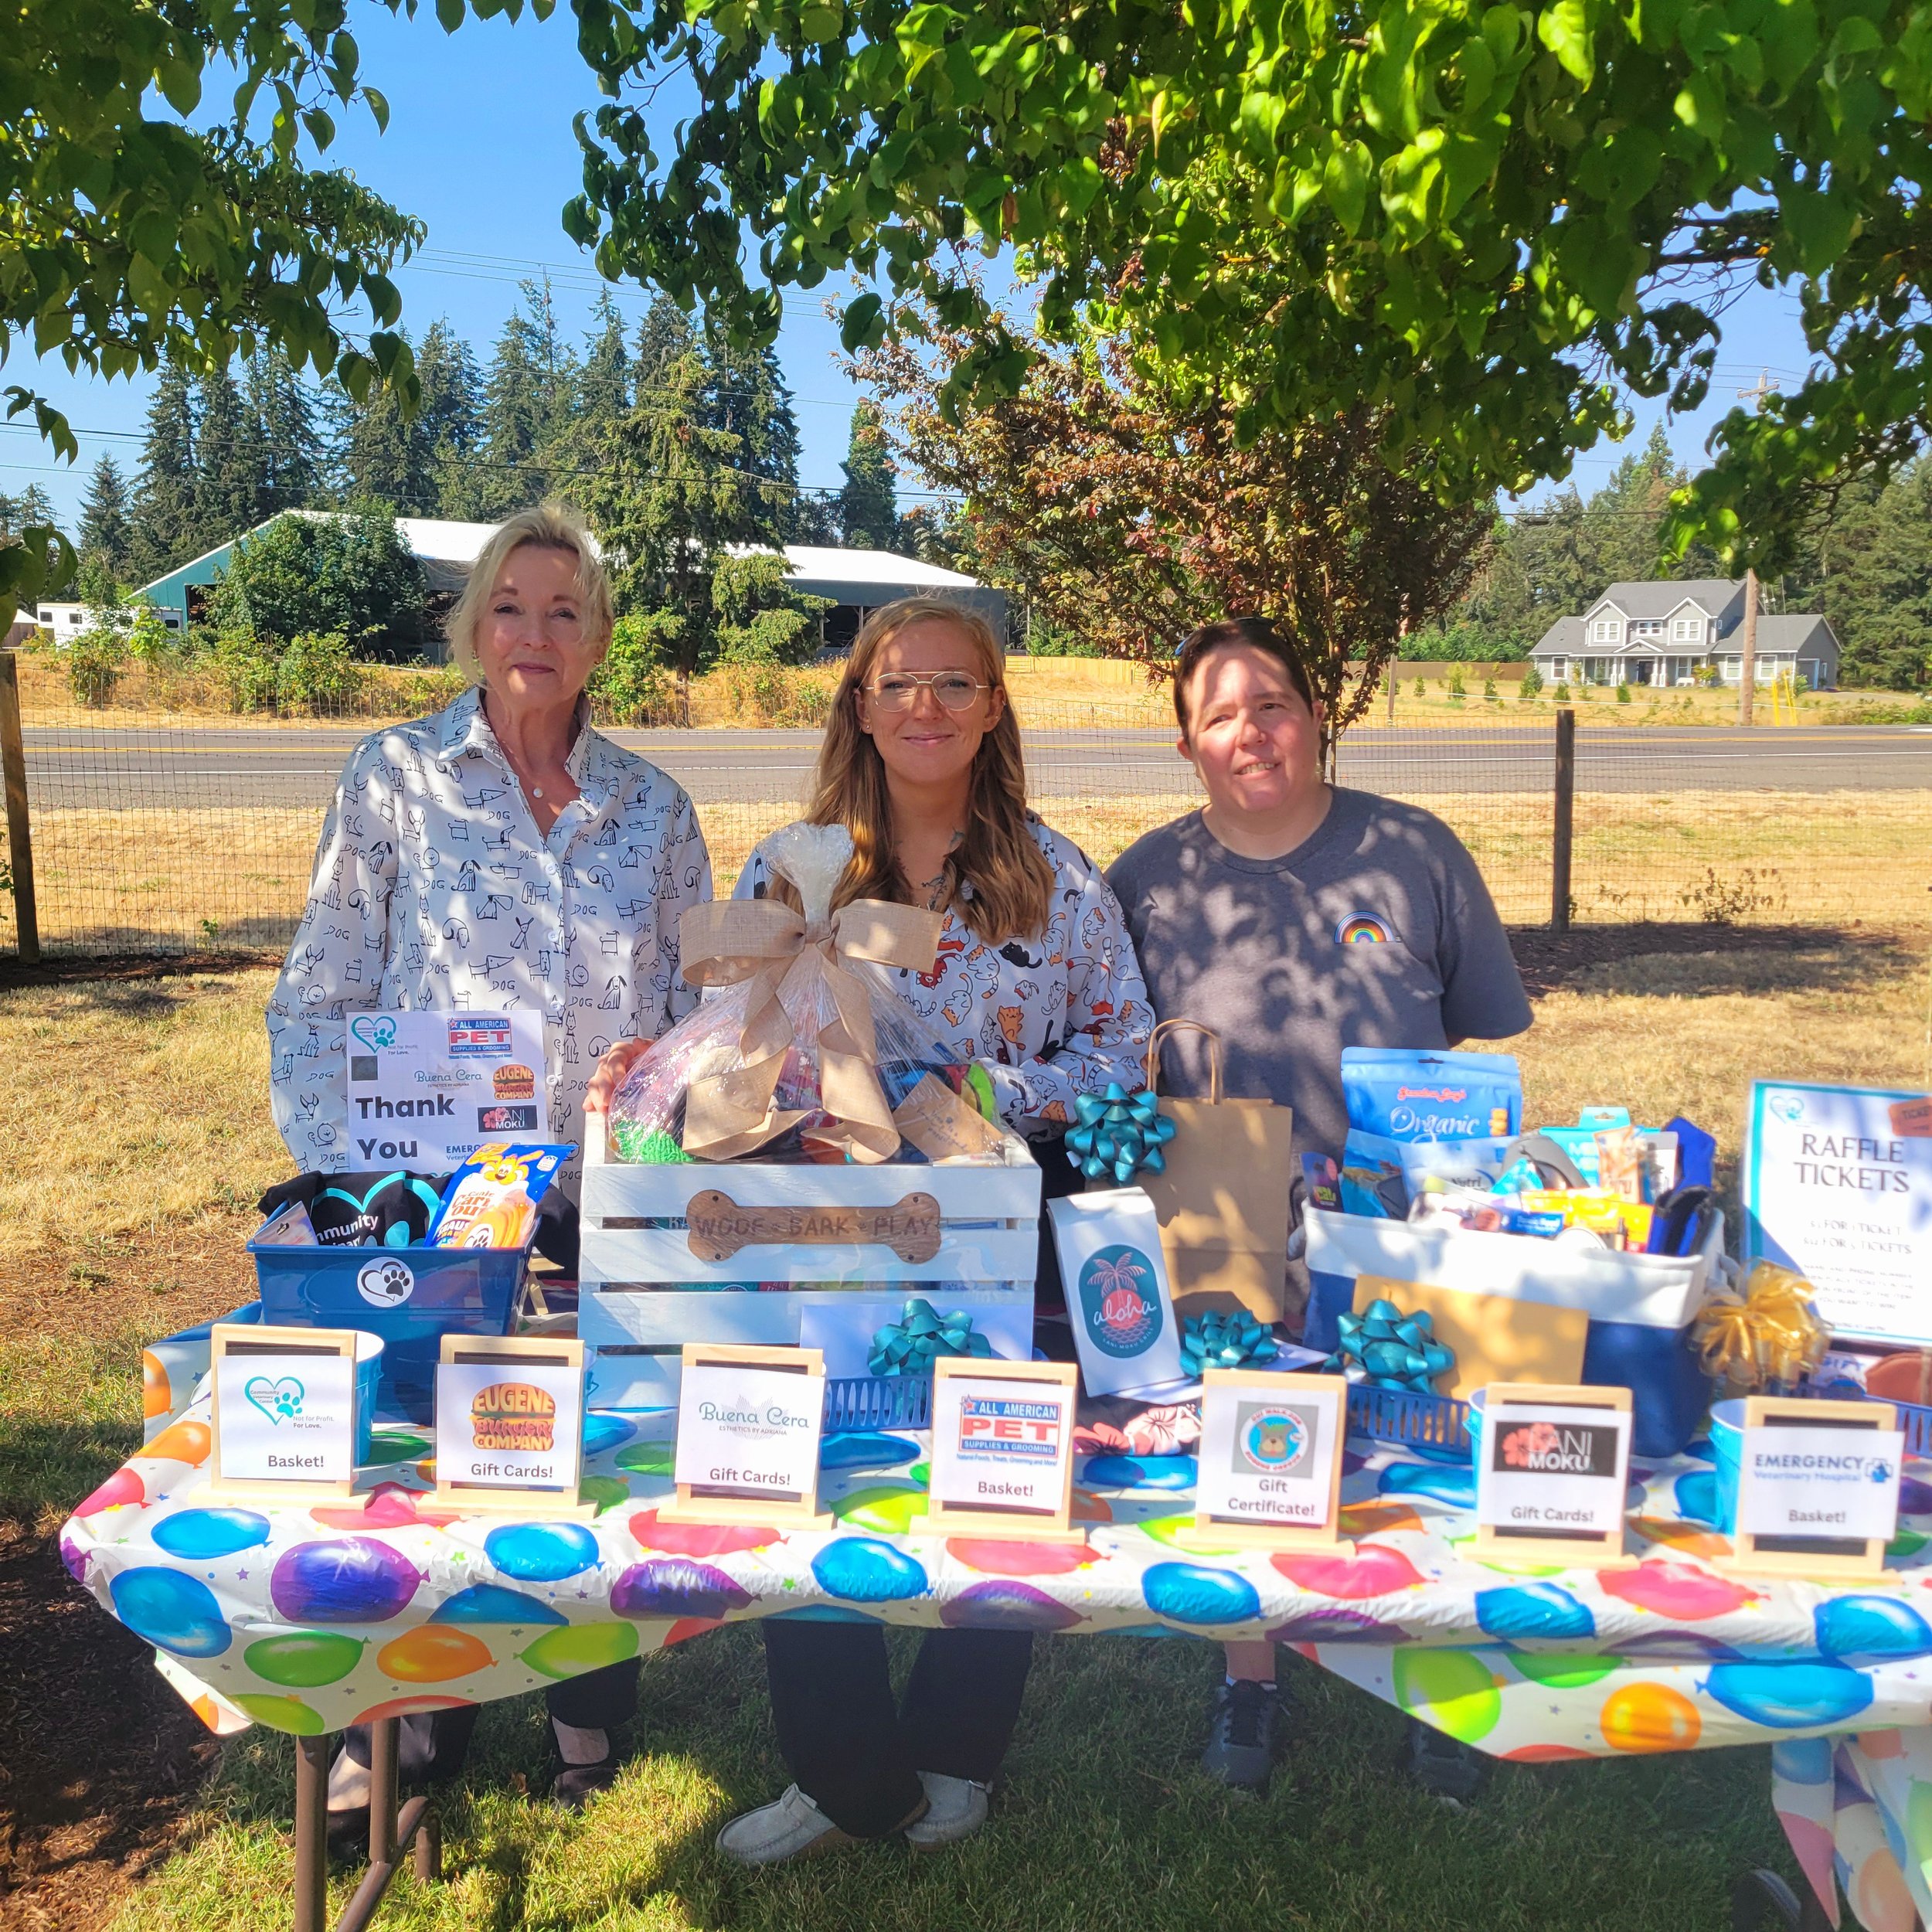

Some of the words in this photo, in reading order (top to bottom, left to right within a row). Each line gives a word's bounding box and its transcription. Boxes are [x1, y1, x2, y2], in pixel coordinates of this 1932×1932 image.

[418, 788, 444, 804] DOG
[486, 811, 511, 821] DOG
[340, 843, 366, 860] DOG
[518, 851, 538, 861] DOG
[420, 879, 445, 889] DOG
[570, 903, 597, 916] DOG
[323, 925, 350, 940] DOG
[634, 922, 651, 933] DOG
[426, 964, 450, 975] DOG
[489, 981, 516, 992] DOG
[568, 996, 594, 1008] DOG
[451, 1030, 509, 1043] PET
[309, 1071, 334, 1082] DOG
[414, 1070, 451, 1082] Buena
[456, 1070, 482, 1080] Cera
[495, 1066, 533, 1080] EUGENE
[495, 1091, 534, 1100] COMPANY
[355, 1094, 455, 1119] Thank
[1902, 1105, 1930, 1119] TICKE
[495, 1121, 525, 1129] MOKU
[1390, 1107, 1481, 1144] Organic
[357, 1138, 418, 1160] You
[446, 1145, 479, 1154] EMERG
[1801, 1134, 1904, 1163] RAFFLE
[319, 1152, 345, 1165] DOG
[1794, 1162, 1910, 1193] TICKETS
[317, 1214, 378, 1242] mmunity
[789, 1216, 851, 1236] BARK
[873, 1216, 934, 1236] PLAY
[1094, 1294, 1157, 1325] aloha
[473, 1383, 554, 1413] EUGENE
[699, 1402, 759, 1423] Buena
[767, 1406, 809, 1428] Cera
[979, 1402, 998, 1414] ALL
[1004, 1403, 1056, 1418] AMERICAN
[962, 1417, 1058, 1441] PET
[474, 1434, 553, 1451] COMPANY
[964, 1440, 1001, 1450] SUPPLIES
[1011, 1444, 1054, 1454] GROOMING
[1529, 1428, 1592, 1456] LANI
[268, 1455, 324, 1468] Basket!
[1528, 1451, 1590, 1471] MOKU
[1755, 1454, 1864, 1469] EMERGENCY
[471, 1463, 499, 1476] Gift
[504, 1464, 553, 1478] Cards!
[710, 1468, 739, 1481] Gift
[743, 1470, 791, 1485] Cards!
[978, 1481, 1033, 1496] Basket!
[1259, 1479, 1287, 1493] Gift
[1228, 1498, 1315, 1516] Certificate!
[1511, 1507, 1540, 1519] Gift
[1544, 1508, 1594, 1522] Cards!
[1788, 1509, 1846, 1523] Basket!
